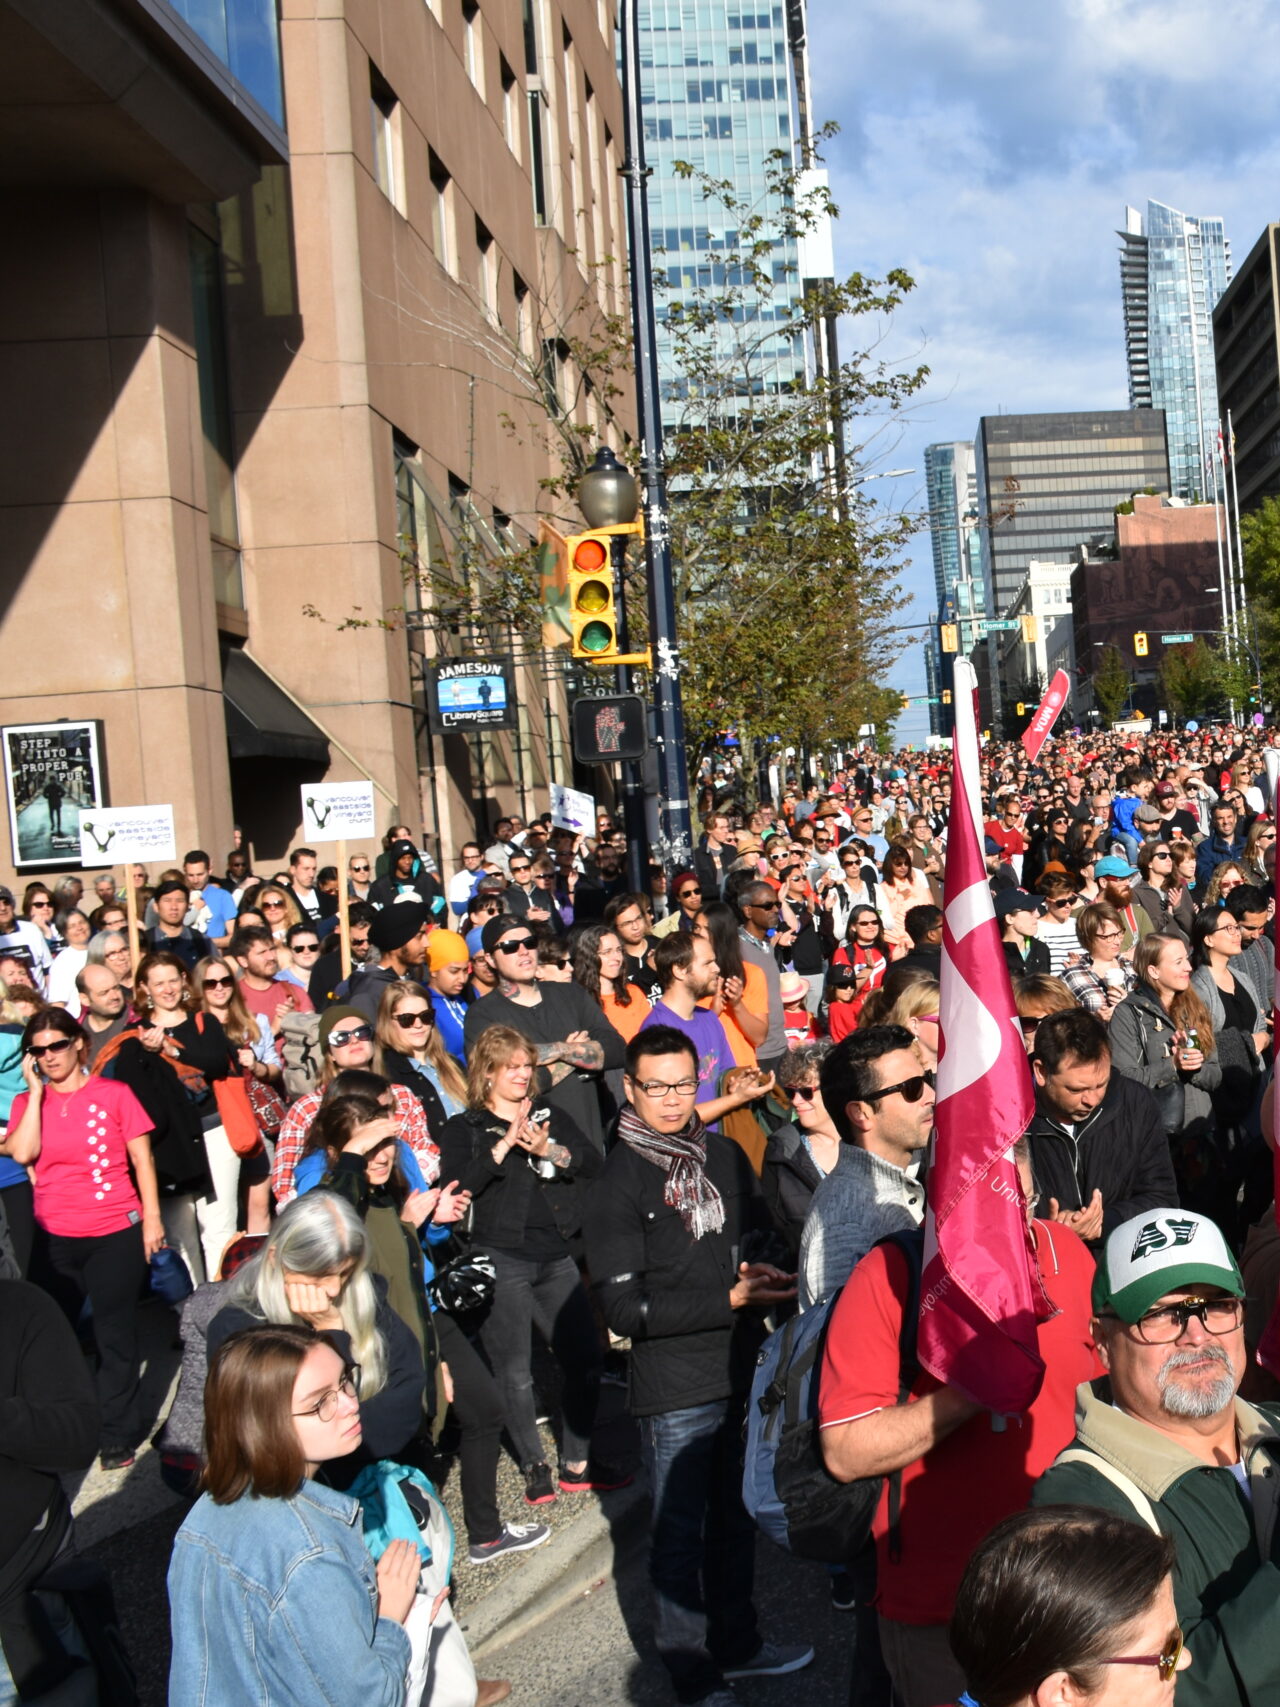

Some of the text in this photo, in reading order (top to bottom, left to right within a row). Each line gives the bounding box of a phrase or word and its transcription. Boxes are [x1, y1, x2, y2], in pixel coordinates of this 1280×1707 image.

[438, 662, 503, 680] JAMESON
[20, 738, 52, 749] STEP
[36, 747, 83, 759] INTO A
[22, 761, 69, 773] PROPER
[59, 772, 83, 782] PUB
